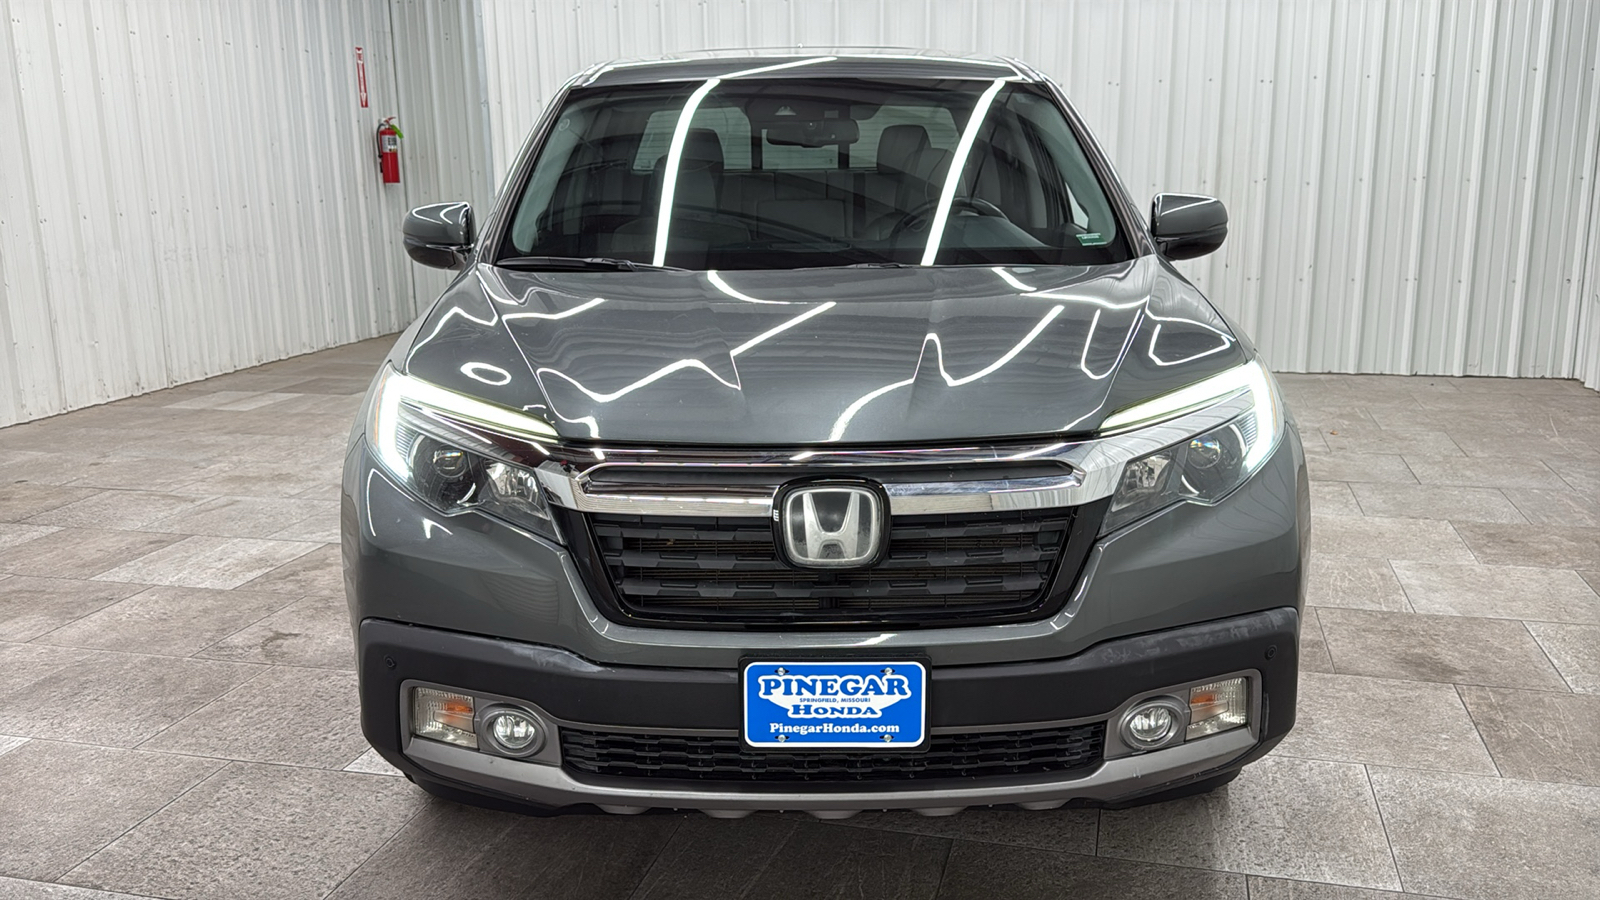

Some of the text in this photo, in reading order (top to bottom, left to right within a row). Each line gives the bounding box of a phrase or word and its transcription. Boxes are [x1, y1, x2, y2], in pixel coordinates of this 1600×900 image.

[762, 678, 908, 696] PINEGAR
[791, 704, 878, 716] HONDA
[769, 722, 900, 735] PinegarHonda.com
